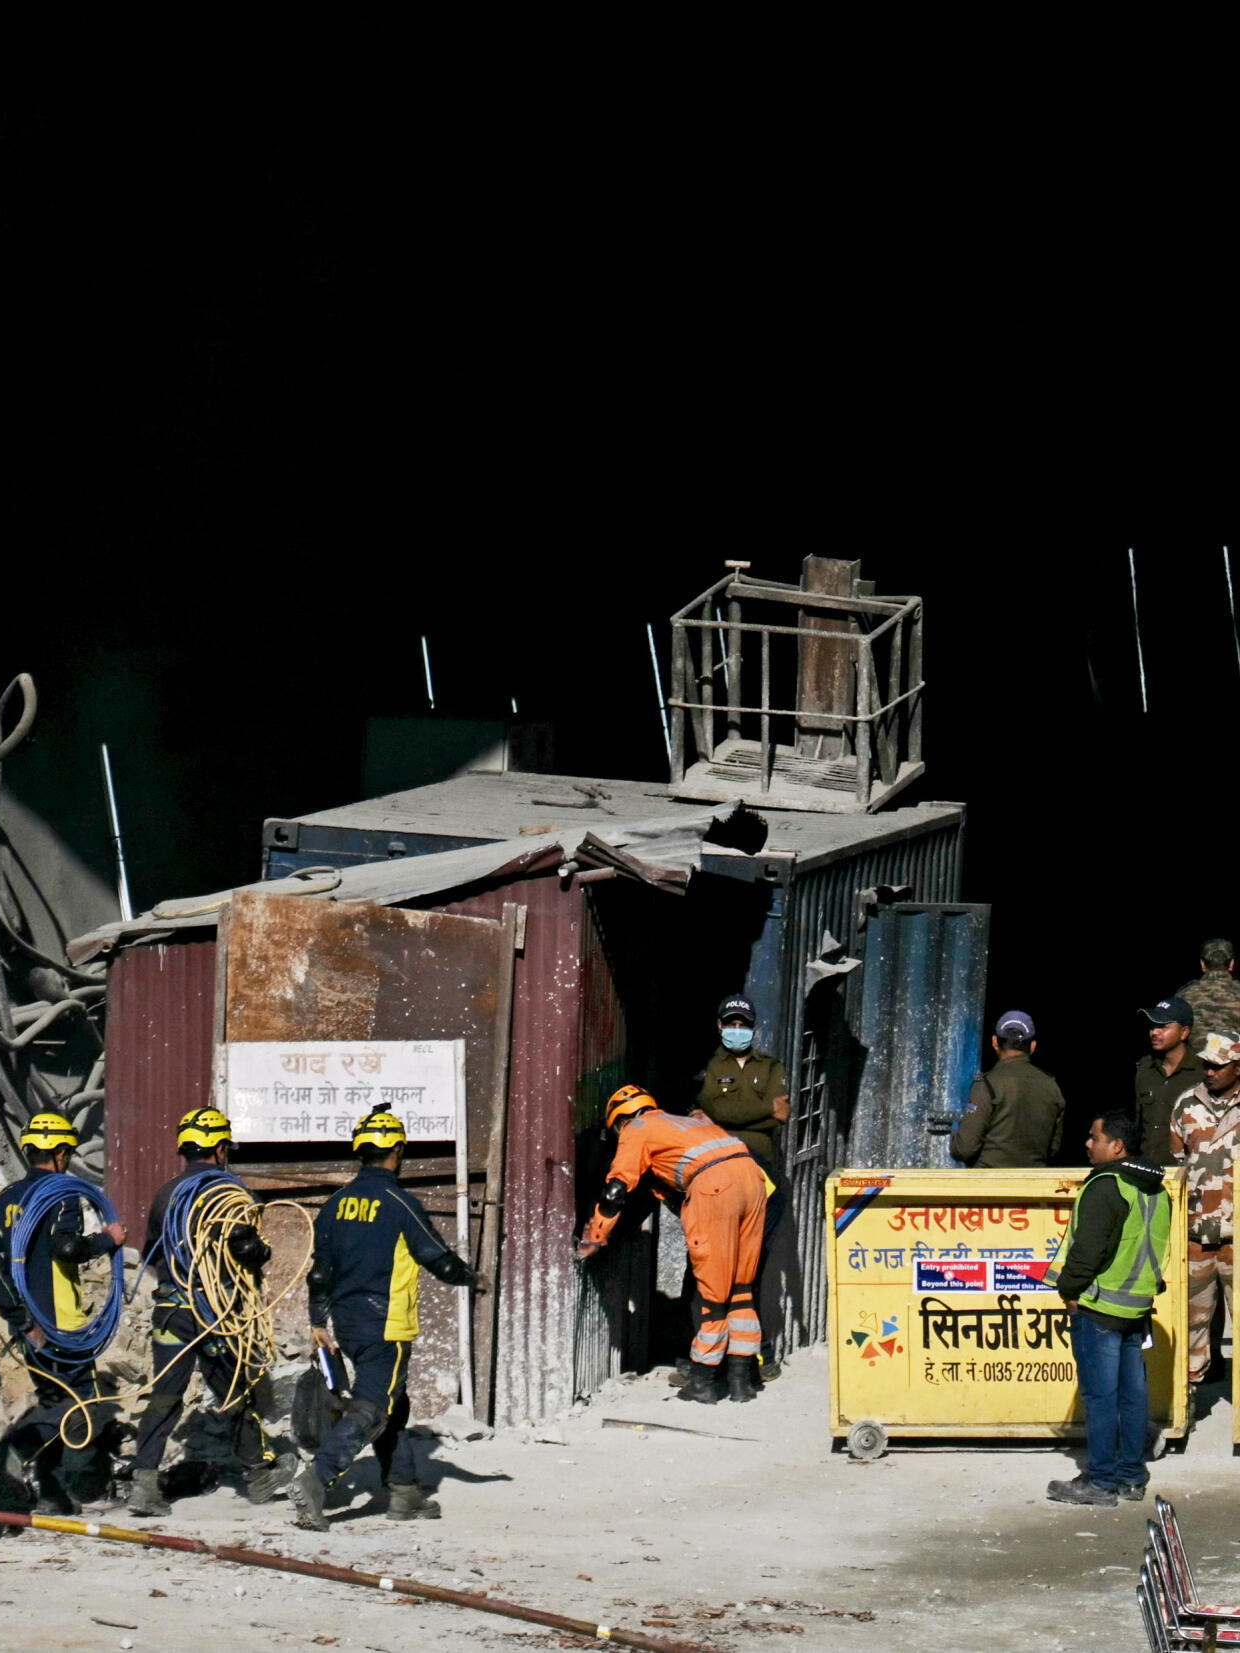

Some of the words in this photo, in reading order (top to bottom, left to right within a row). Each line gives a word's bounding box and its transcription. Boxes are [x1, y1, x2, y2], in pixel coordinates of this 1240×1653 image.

[280, 1053, 330, 1075] याद
[318, 1081, 340, 1104] जो
[280, 1110, 311, 1133] कभी
[315, 1116, 330, 1134] न
[336, 1197, 381, 1222] SDRF
[848, 1241, 869, 1272] दो
[873, 1248, 906, 1270] गज
[921, 1263, 940, 1272] Entry
[942, 1263, 979, 1272] prohibited
[921, 1280, 948, 1288] Beyond
[918, 1294, 1023, 1350] सिनर्जी
